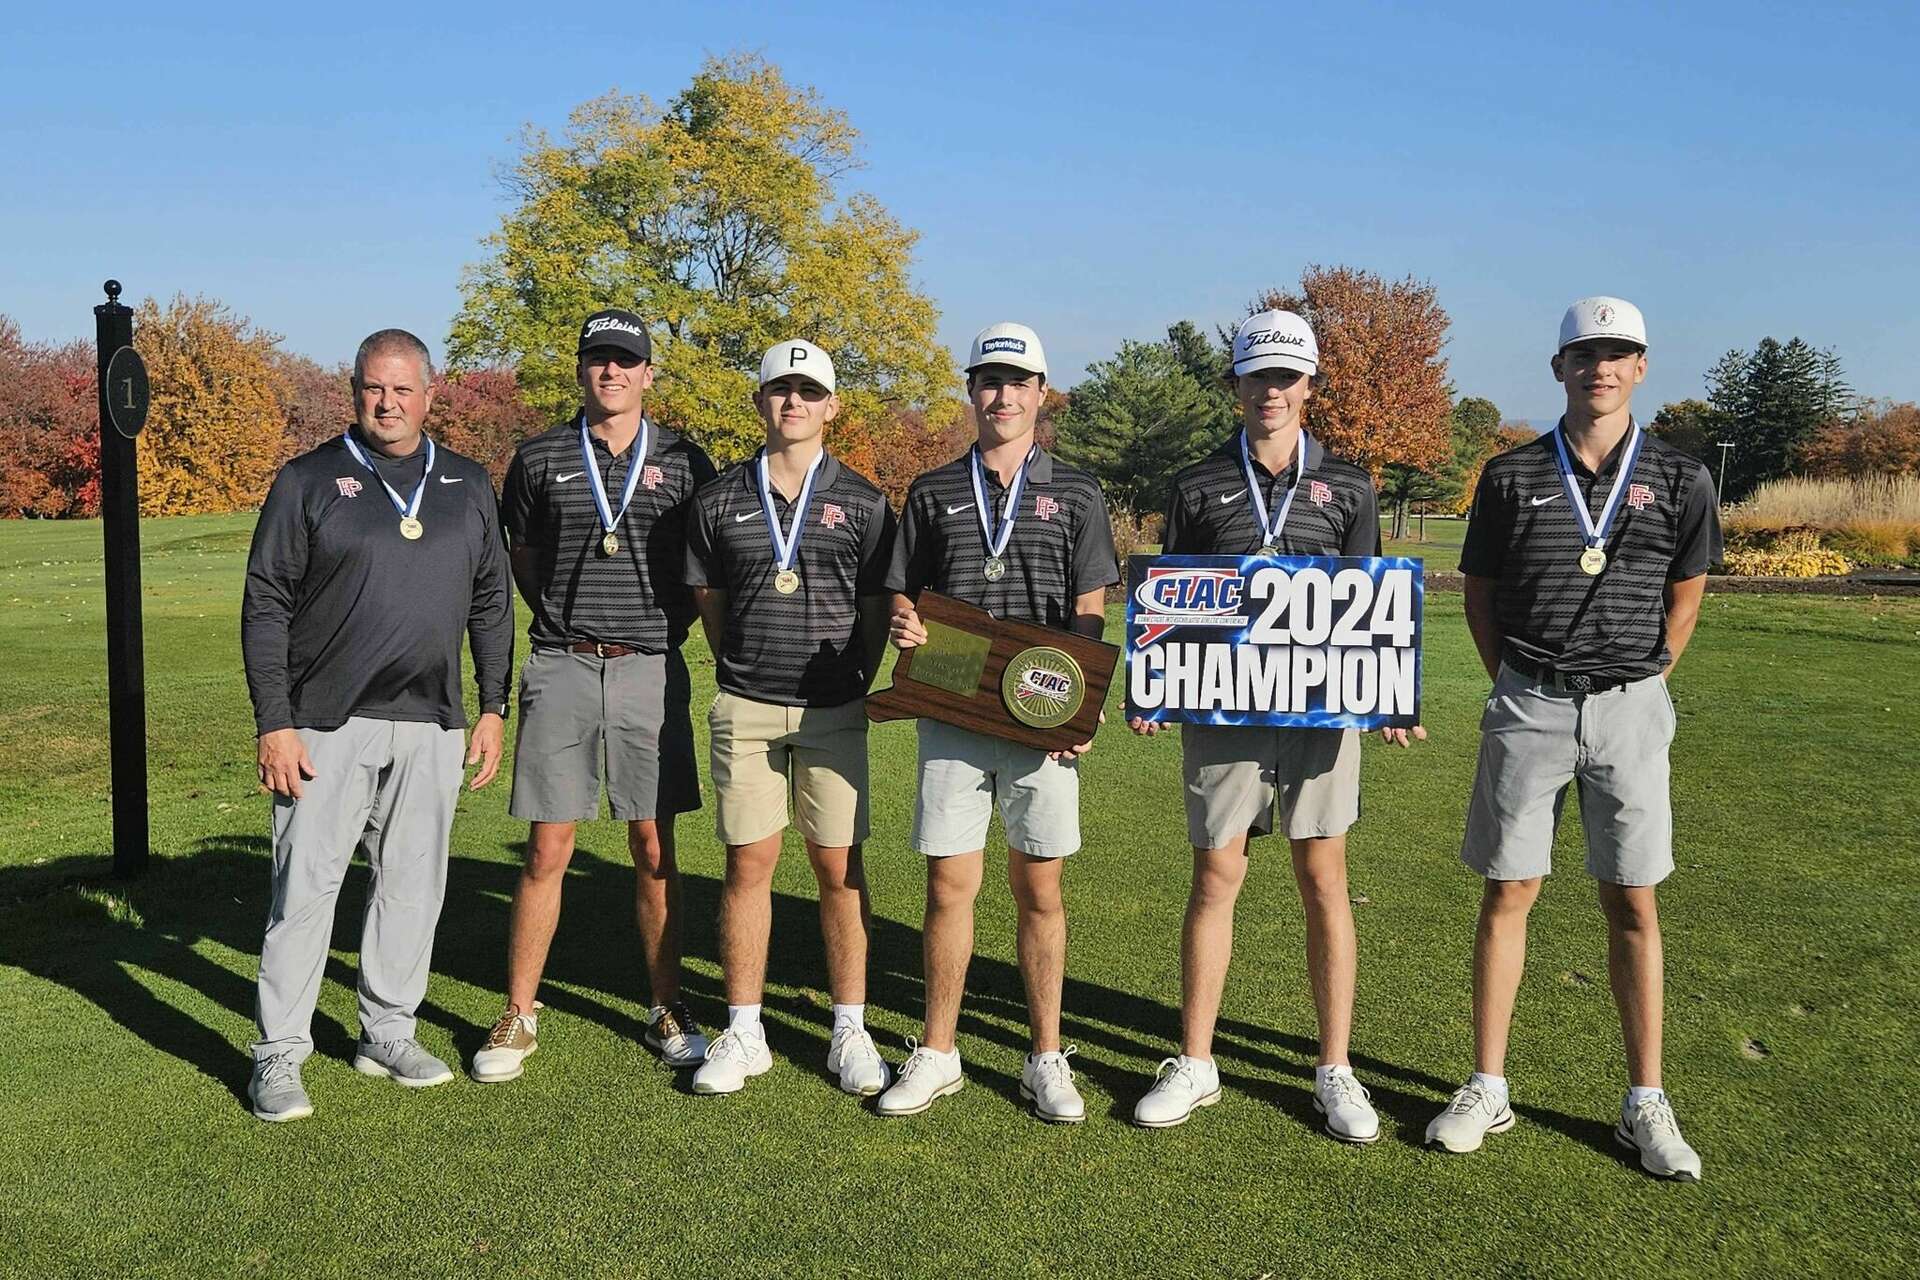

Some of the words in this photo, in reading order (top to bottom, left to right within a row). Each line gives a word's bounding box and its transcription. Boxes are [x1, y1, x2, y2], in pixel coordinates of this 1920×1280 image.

[584, 316, 642, 338] Titleist
[1243, 328, 1306, 351] Titleist
[789, 347, 808, 368] P
[121, 377, 137, 409] 1
[1153, 577, 1244, 609] CIAC
[1250, 567, 1415, 647] 2024
[1029, 670, 1070, 693] CIAC
[1130, 642, 1415, 715] CHAMPION
